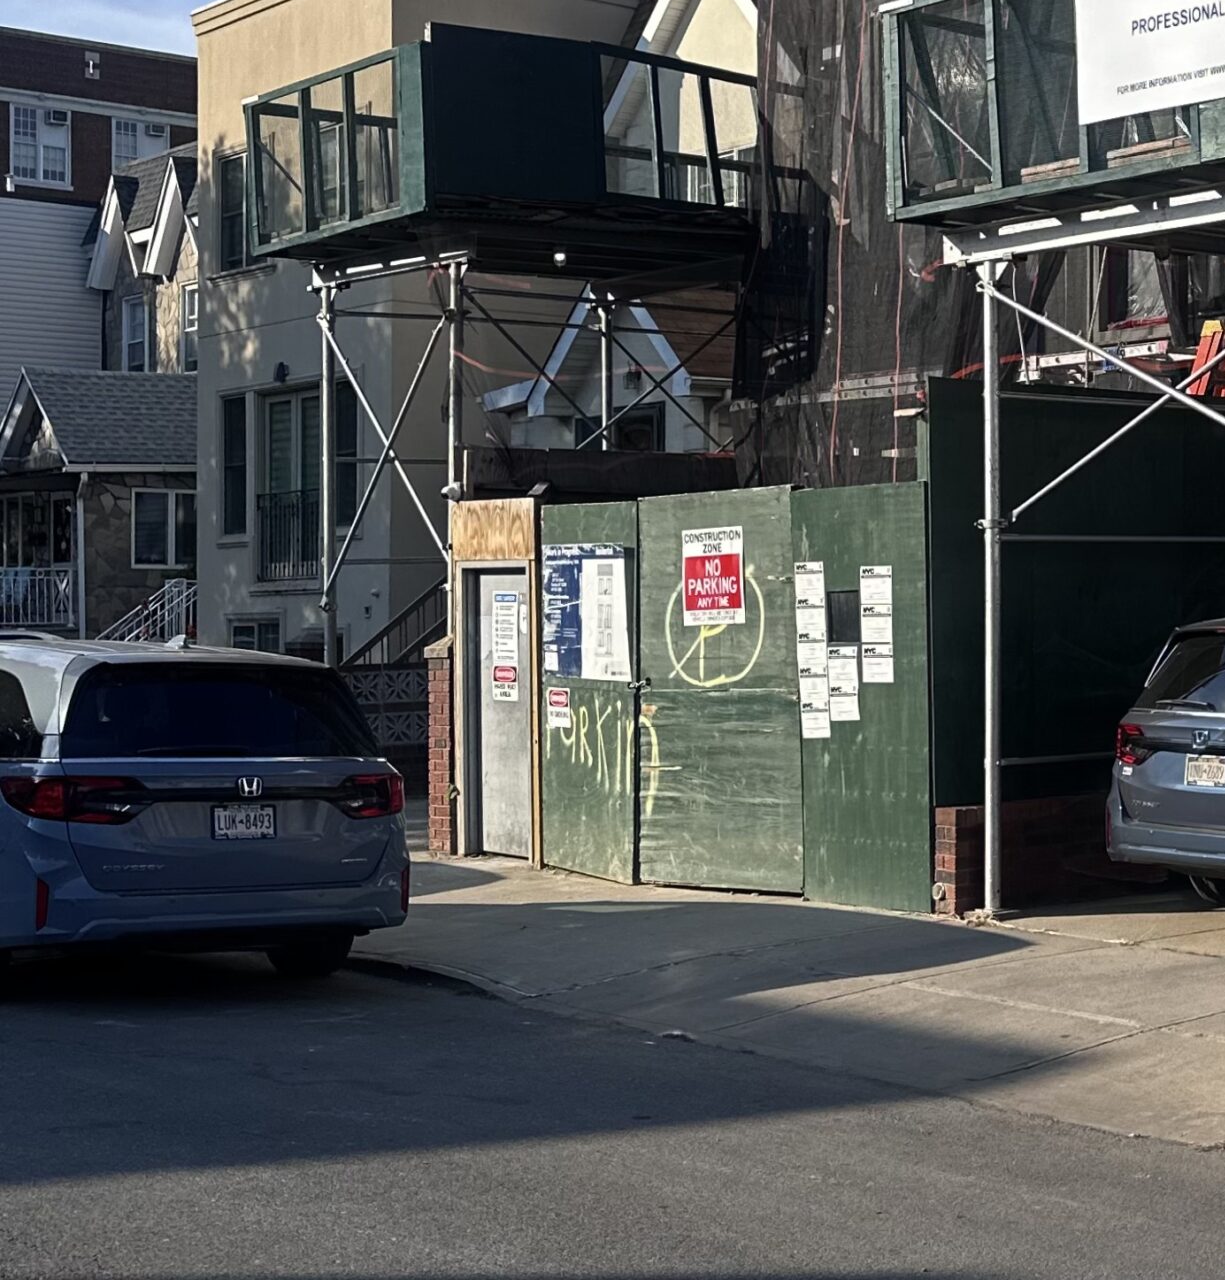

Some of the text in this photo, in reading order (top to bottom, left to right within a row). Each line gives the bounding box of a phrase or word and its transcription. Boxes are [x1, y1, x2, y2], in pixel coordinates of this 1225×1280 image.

[1131, 1, 1225, 37] PROFESSIONAL
[1116, 86, 1129, 95] FOR
[1130, 81, 1148, 91] MORE
[1149, 71, 1193, 88] INFORMATION
[1194, 68, 1209, 78] VISIT
[684, 529, 741, 544] CONSTRUCTION
[702, 542, 723, 554] ZONE
[704, 558, 722, 577] NO
[687, 576, 738, 596] PARKING
[697, 596, 730, 609] ANY TIME
